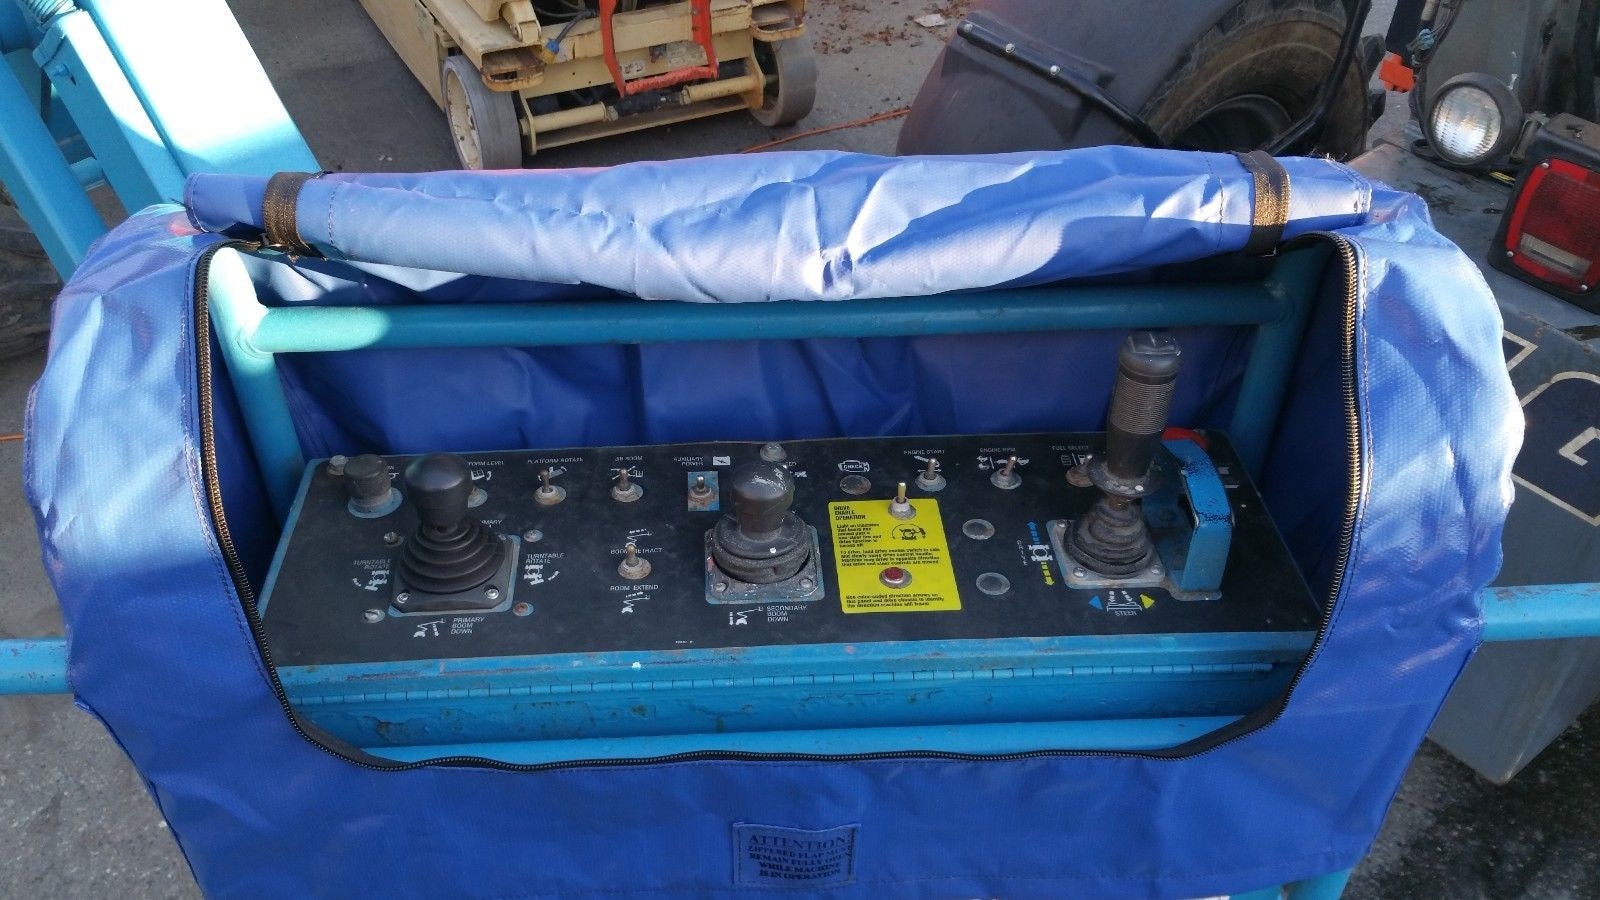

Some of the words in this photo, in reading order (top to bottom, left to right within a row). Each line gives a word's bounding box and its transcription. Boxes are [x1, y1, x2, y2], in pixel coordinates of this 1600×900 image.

[748, 846, 796, 858] ZIPPERED
[749, 853, 788, 863] REMAIN
[759, 861, 792, 871] WHILE
[794, 862, 840, 873] MACHINE
[784, 868, 840, 880] OPERATION
